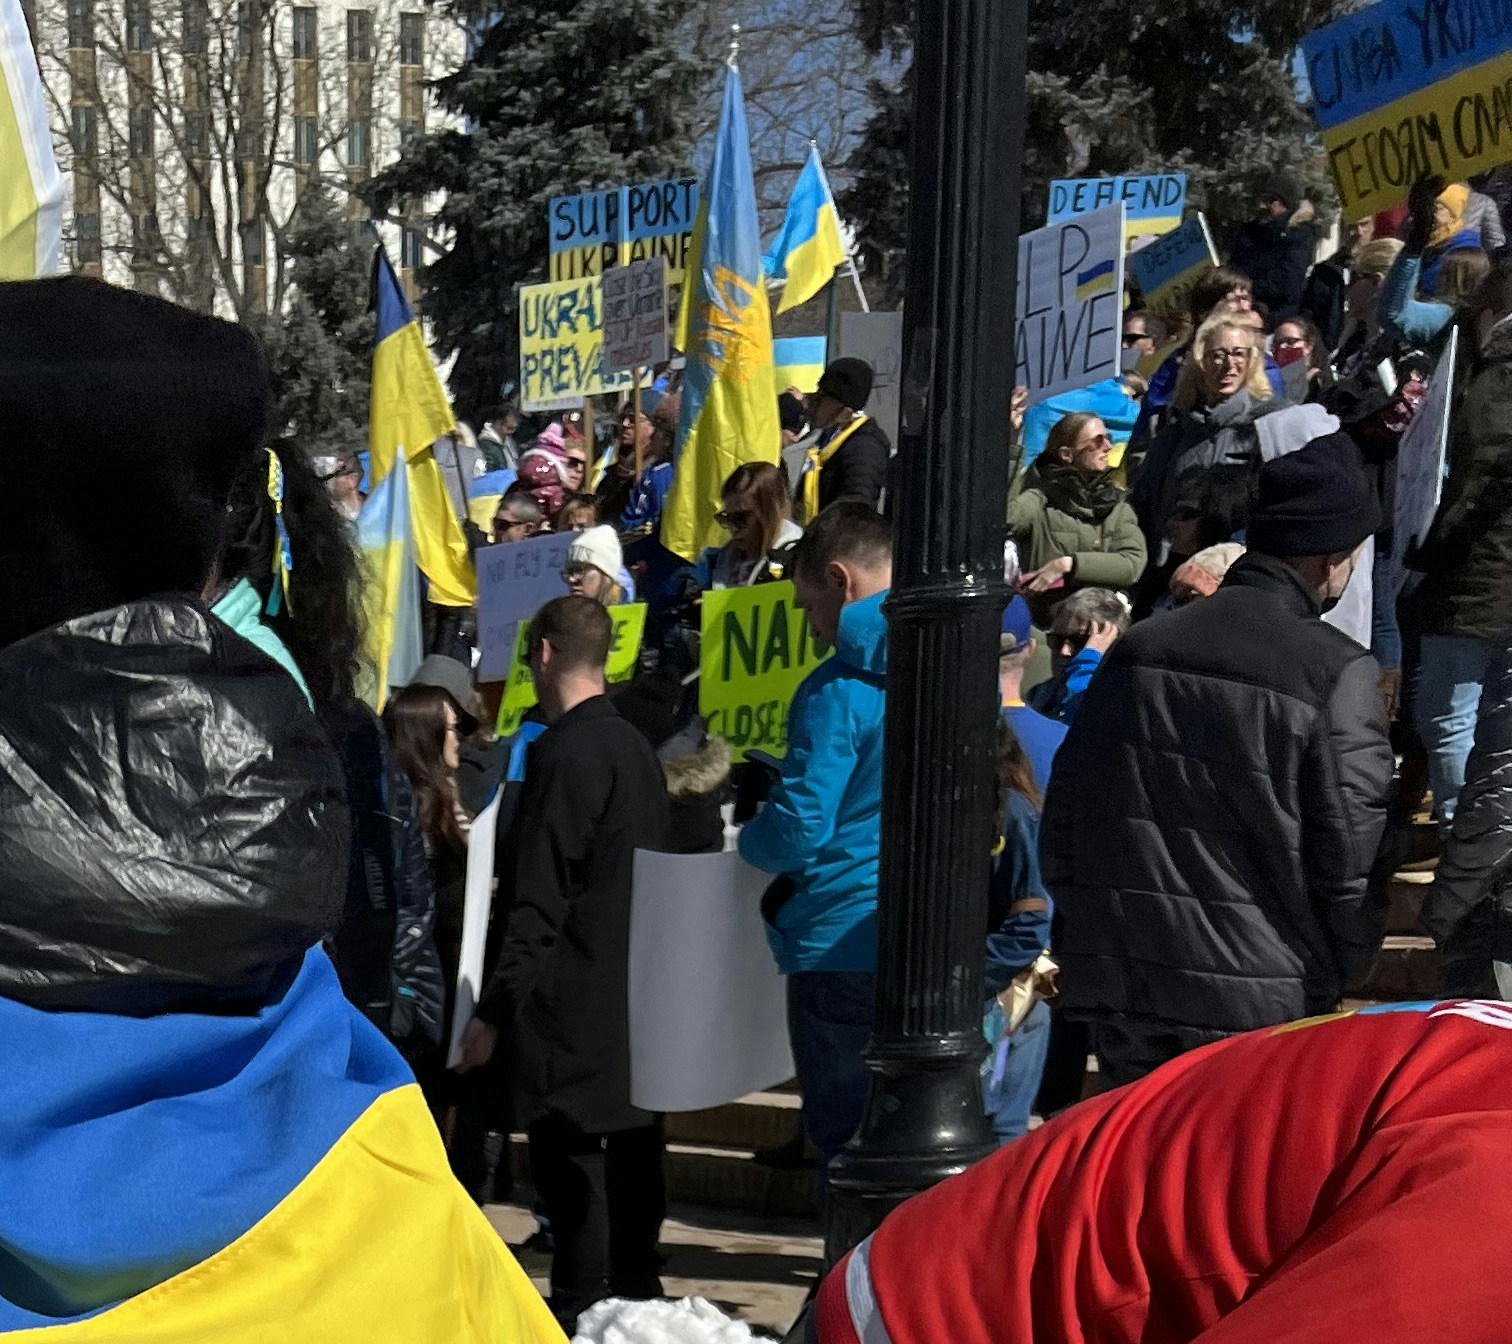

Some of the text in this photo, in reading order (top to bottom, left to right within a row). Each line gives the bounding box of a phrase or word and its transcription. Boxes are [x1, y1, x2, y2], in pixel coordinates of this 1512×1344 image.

[1452, 78, 1512, 159] СЛА
[555, 178, 698, 241] SUPPORT
[524, 280, 605, 341] UKRA
[1022, 224, 1090, 320] LP
[1015, 290, 1117, 390] AINE
